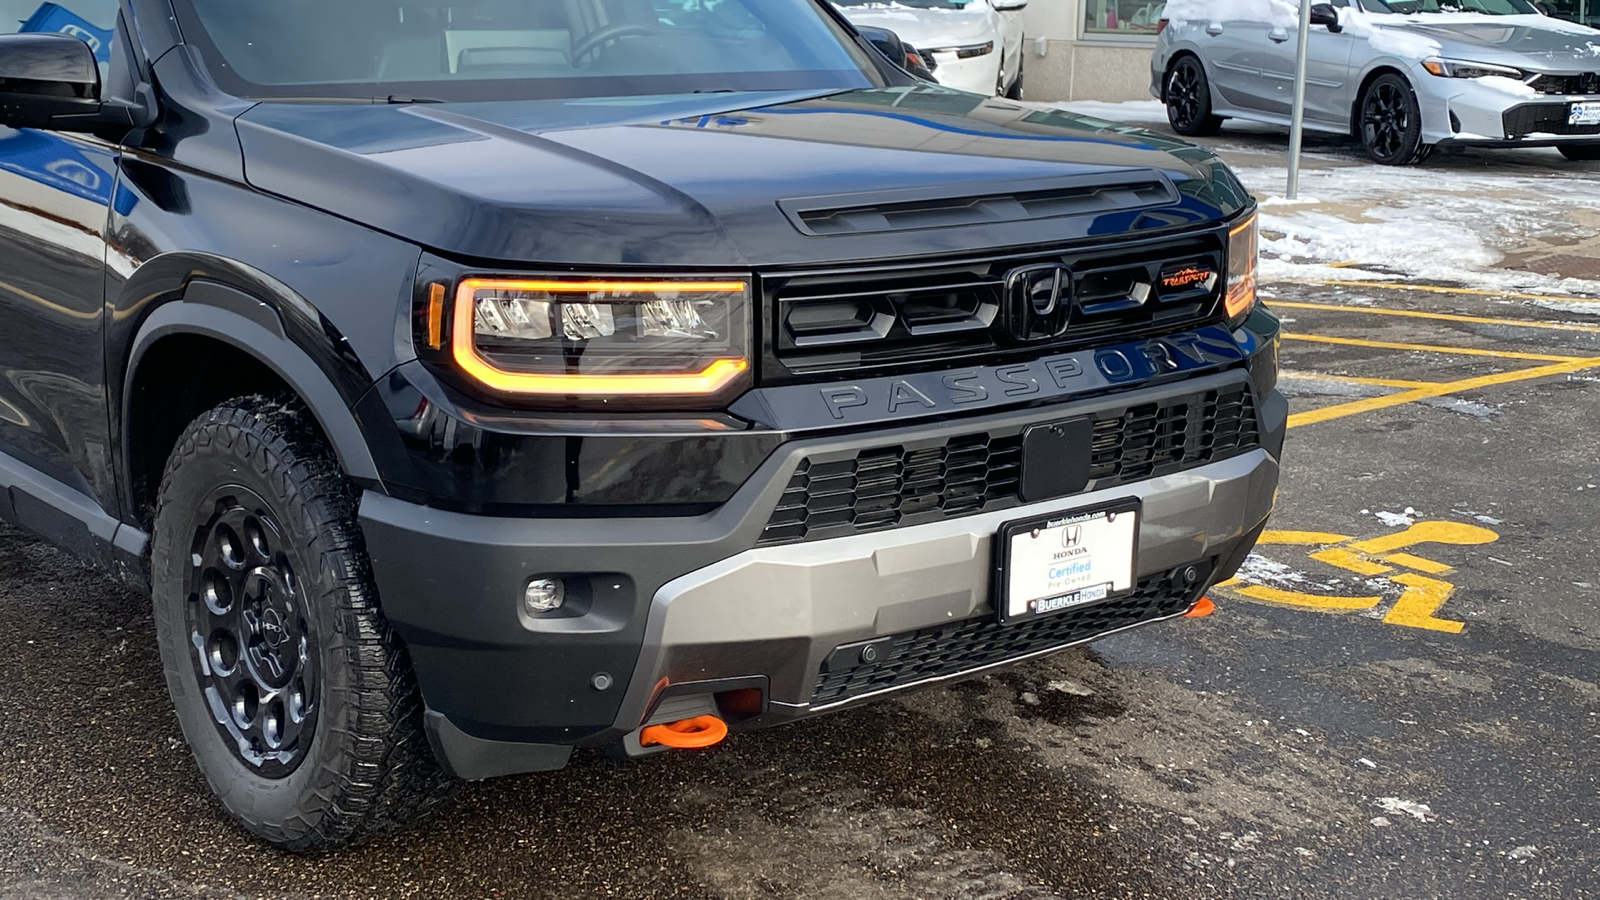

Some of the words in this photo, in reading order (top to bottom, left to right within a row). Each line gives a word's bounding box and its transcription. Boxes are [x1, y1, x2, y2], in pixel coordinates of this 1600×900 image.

[819, 333, 1207, 420] PASSPORT
[1046, 511, 1106, 529] buerklehonda.com
[1053, 546, 1088, 560] HONDA
[1048, 560, 1092, 580] Certified
[1048, 573, 1091, 590] Pre-Owned
[1038, 592, 1080, 611] BUERKLE
[1081, 588, 1105, 601] HONDA
